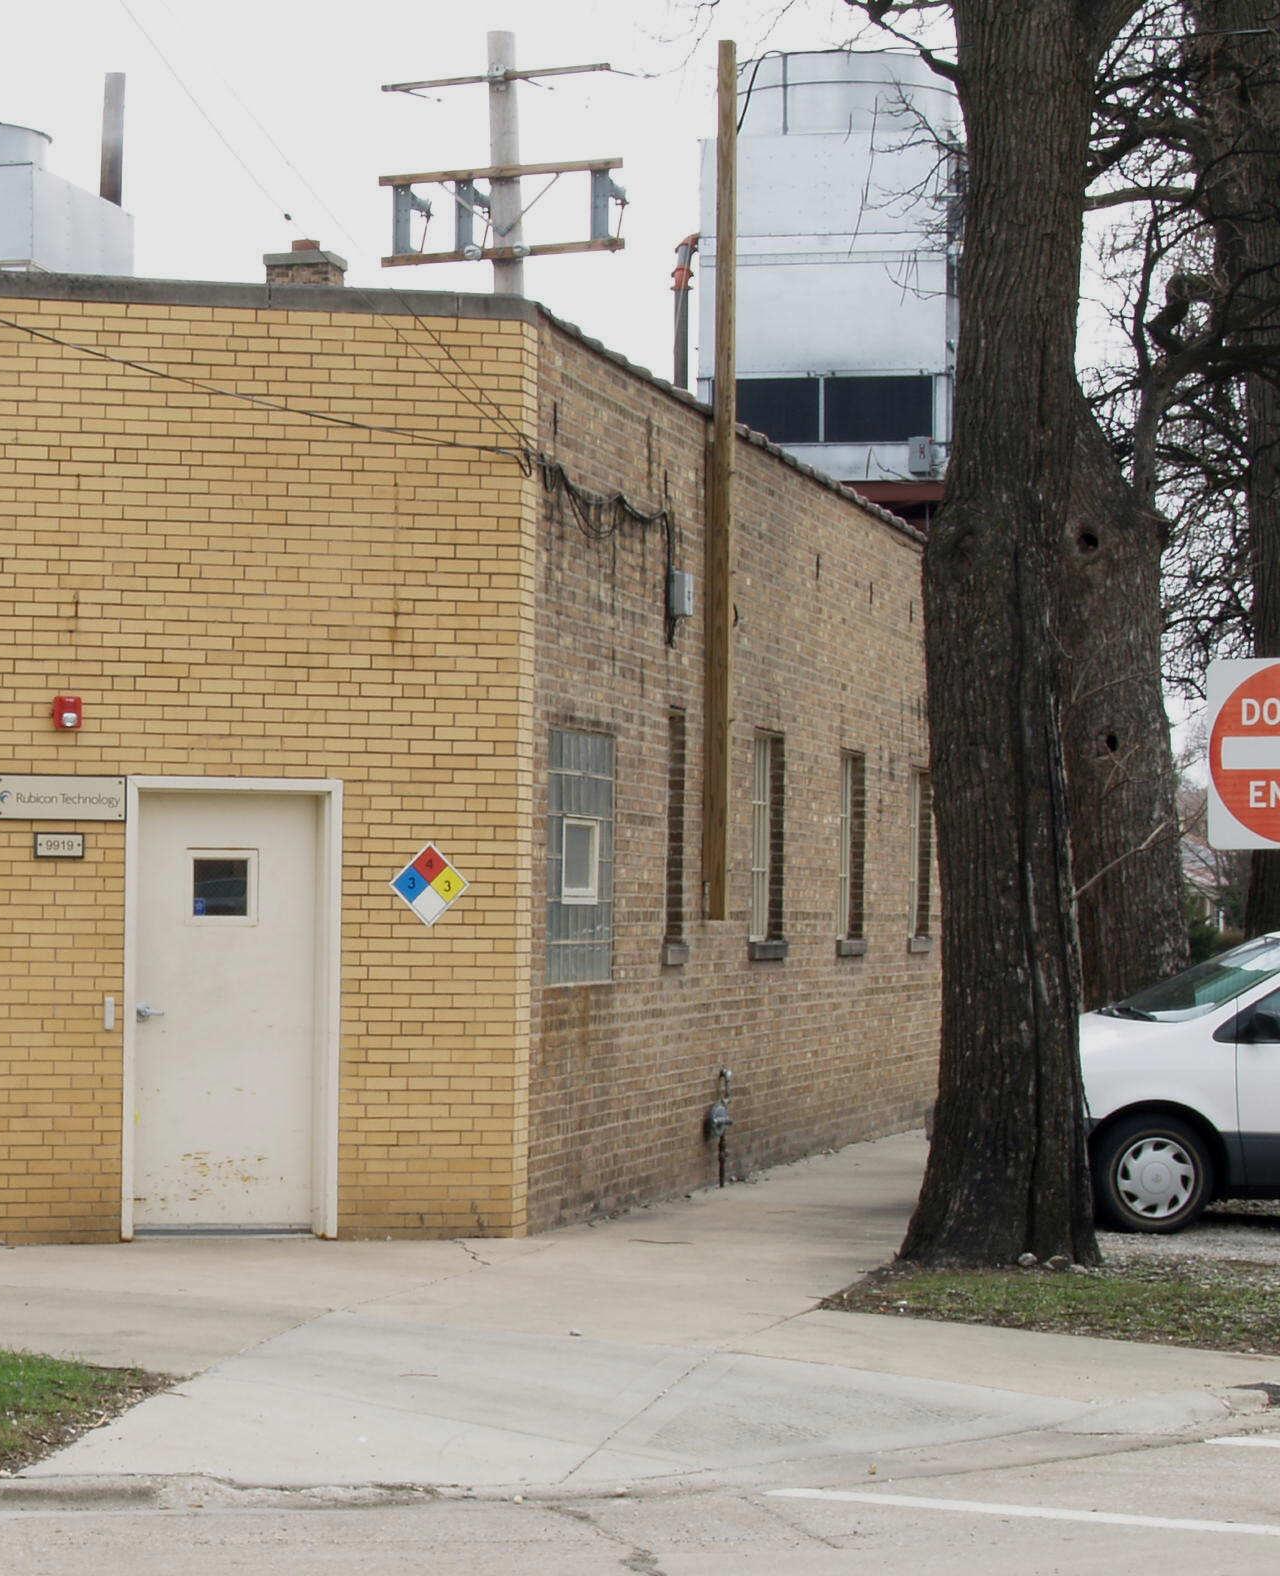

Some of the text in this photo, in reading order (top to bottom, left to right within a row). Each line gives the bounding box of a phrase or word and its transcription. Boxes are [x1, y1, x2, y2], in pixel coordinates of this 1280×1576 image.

[1241, 697, 1280, 726] DO
[16, 792, 120, 808] Rubicon Technology
[45, 840, 74, 851] 9919
[425, 860, 433, 870] 4
[407, 877, 416, 889] 3
[443, 880, 452, 893] 3
